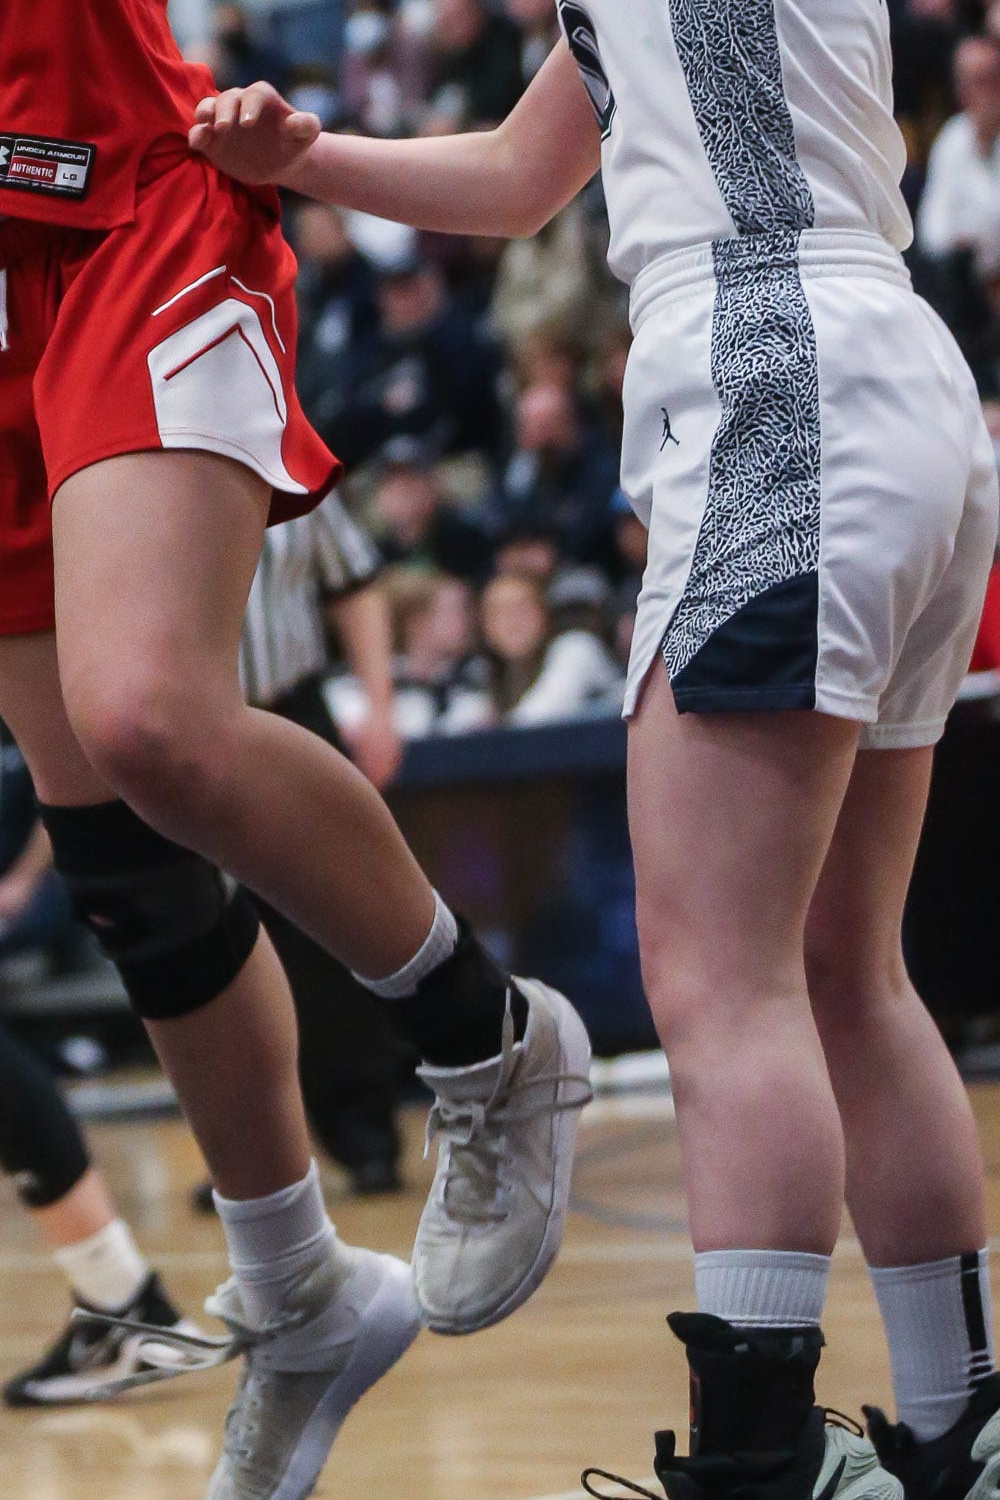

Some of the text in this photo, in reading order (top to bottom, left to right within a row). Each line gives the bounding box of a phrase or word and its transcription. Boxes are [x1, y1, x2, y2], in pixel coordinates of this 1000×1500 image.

[16, 145, 85, 161] UNDER ARMOUR
[11, 162, 54, 178] AUTHENTIC
[62, 172, 78, 181] LG
